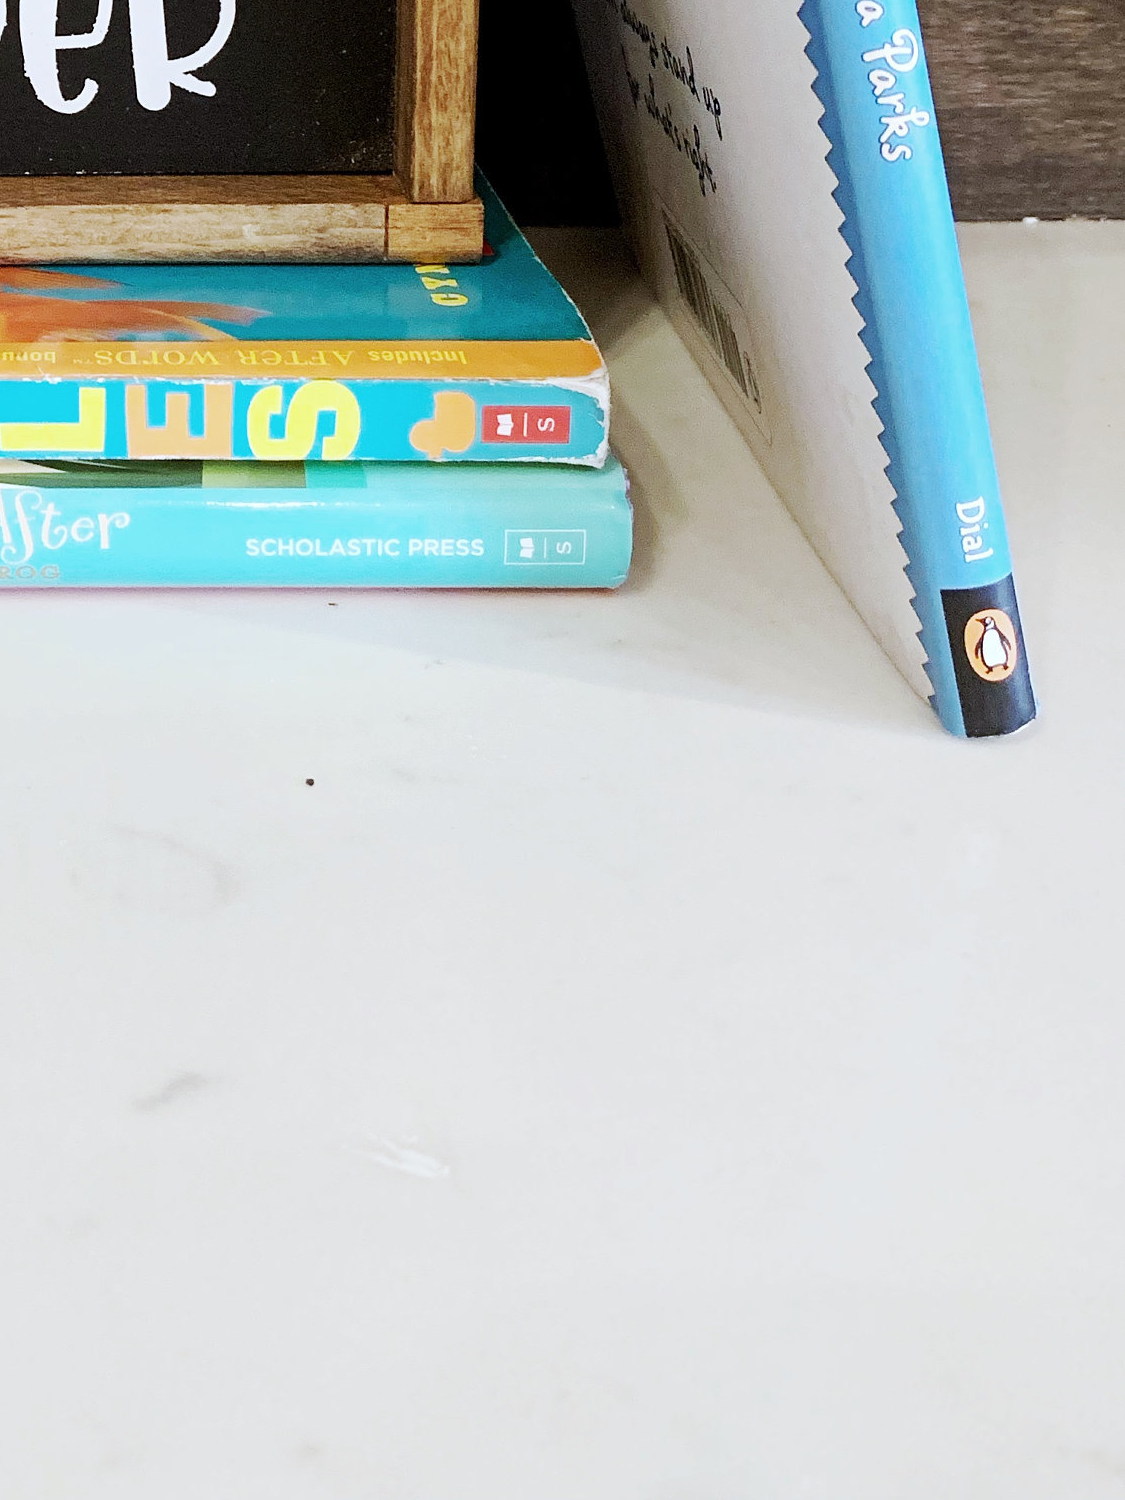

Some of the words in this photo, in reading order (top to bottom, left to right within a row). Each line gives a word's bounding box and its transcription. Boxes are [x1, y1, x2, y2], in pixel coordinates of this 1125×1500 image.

[661, 36, 701, 103] stand
[703, 87, 723, 142] up
[861, 27, 931, 164] Parks
[369, 349, 467, 365] Includes
[245, 537, 401, 558] SCHOLASTIC
[408, 537, 485, 558] PRESS
[955, 495, 995, 563] Dial
